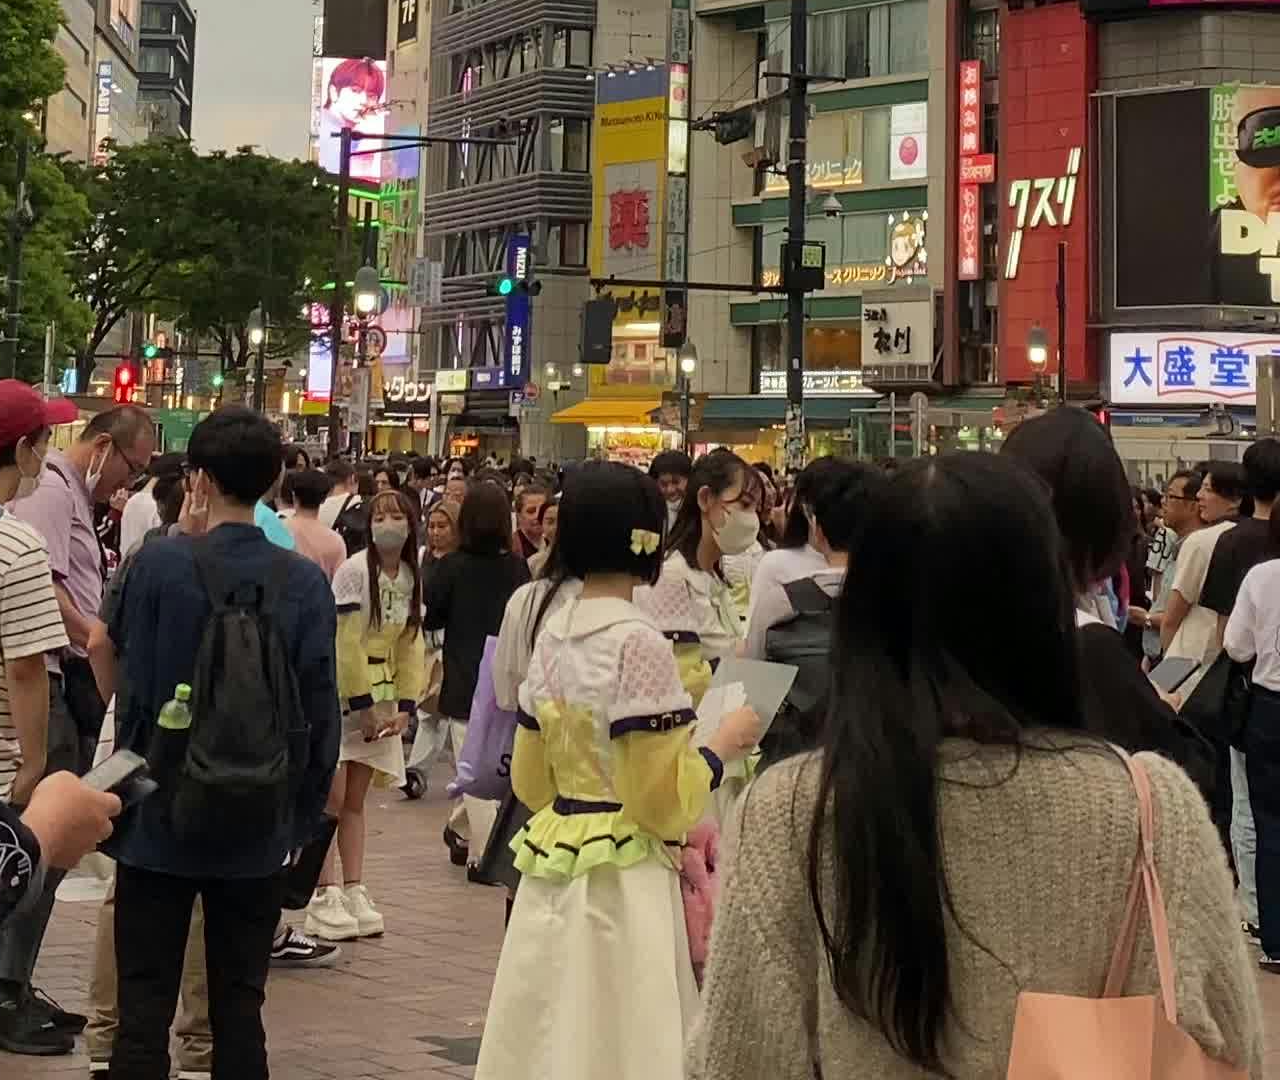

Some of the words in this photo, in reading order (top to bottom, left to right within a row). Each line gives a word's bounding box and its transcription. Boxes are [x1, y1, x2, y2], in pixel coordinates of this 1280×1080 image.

[402, 0, 417, 24] 7F
[1004, 148, 1082, 279] クスリ
